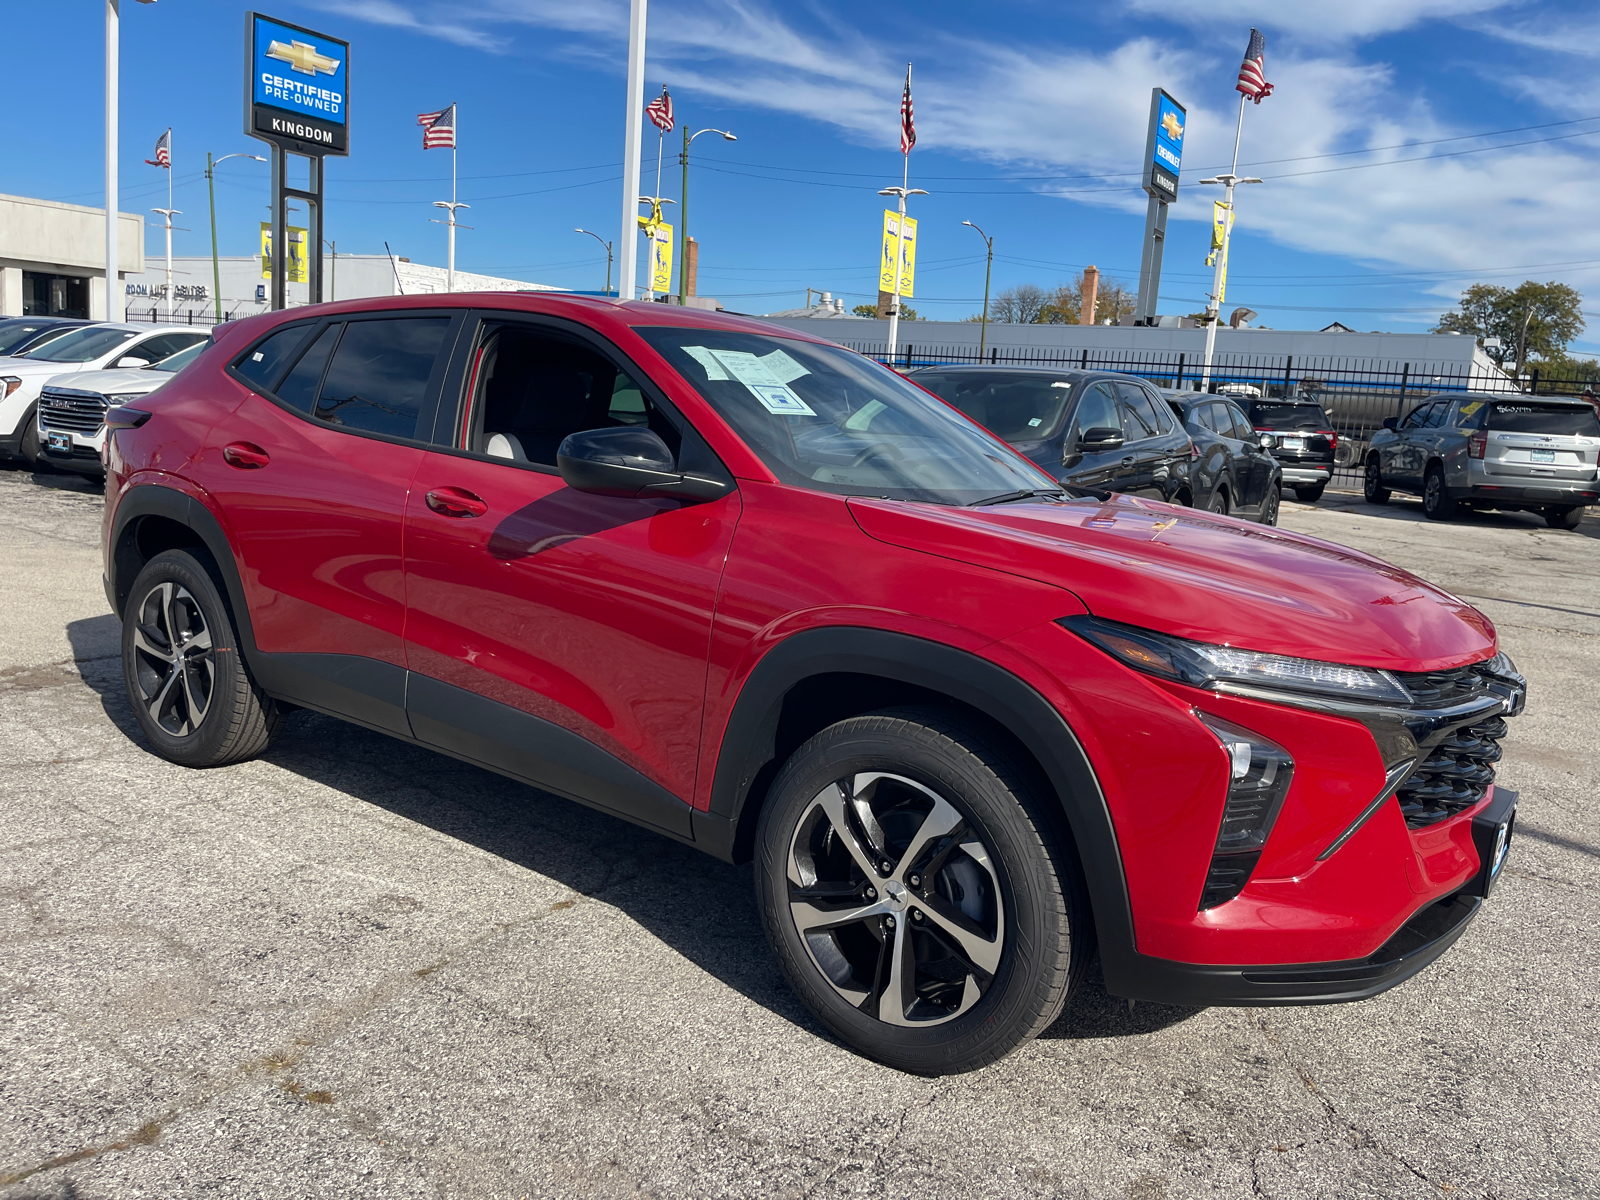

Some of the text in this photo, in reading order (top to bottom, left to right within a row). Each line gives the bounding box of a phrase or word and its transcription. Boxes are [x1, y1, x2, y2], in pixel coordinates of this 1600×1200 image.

[262, 73, 342, 104] CERTIFIED
[265, 85, 339, 114] PRE-OWNED
[272, 118, 333, 144] KINGDOM
[1157, 144, 1180, 169] CHEVROLET
[1156, 173, 1175, 193] KINGDOM
